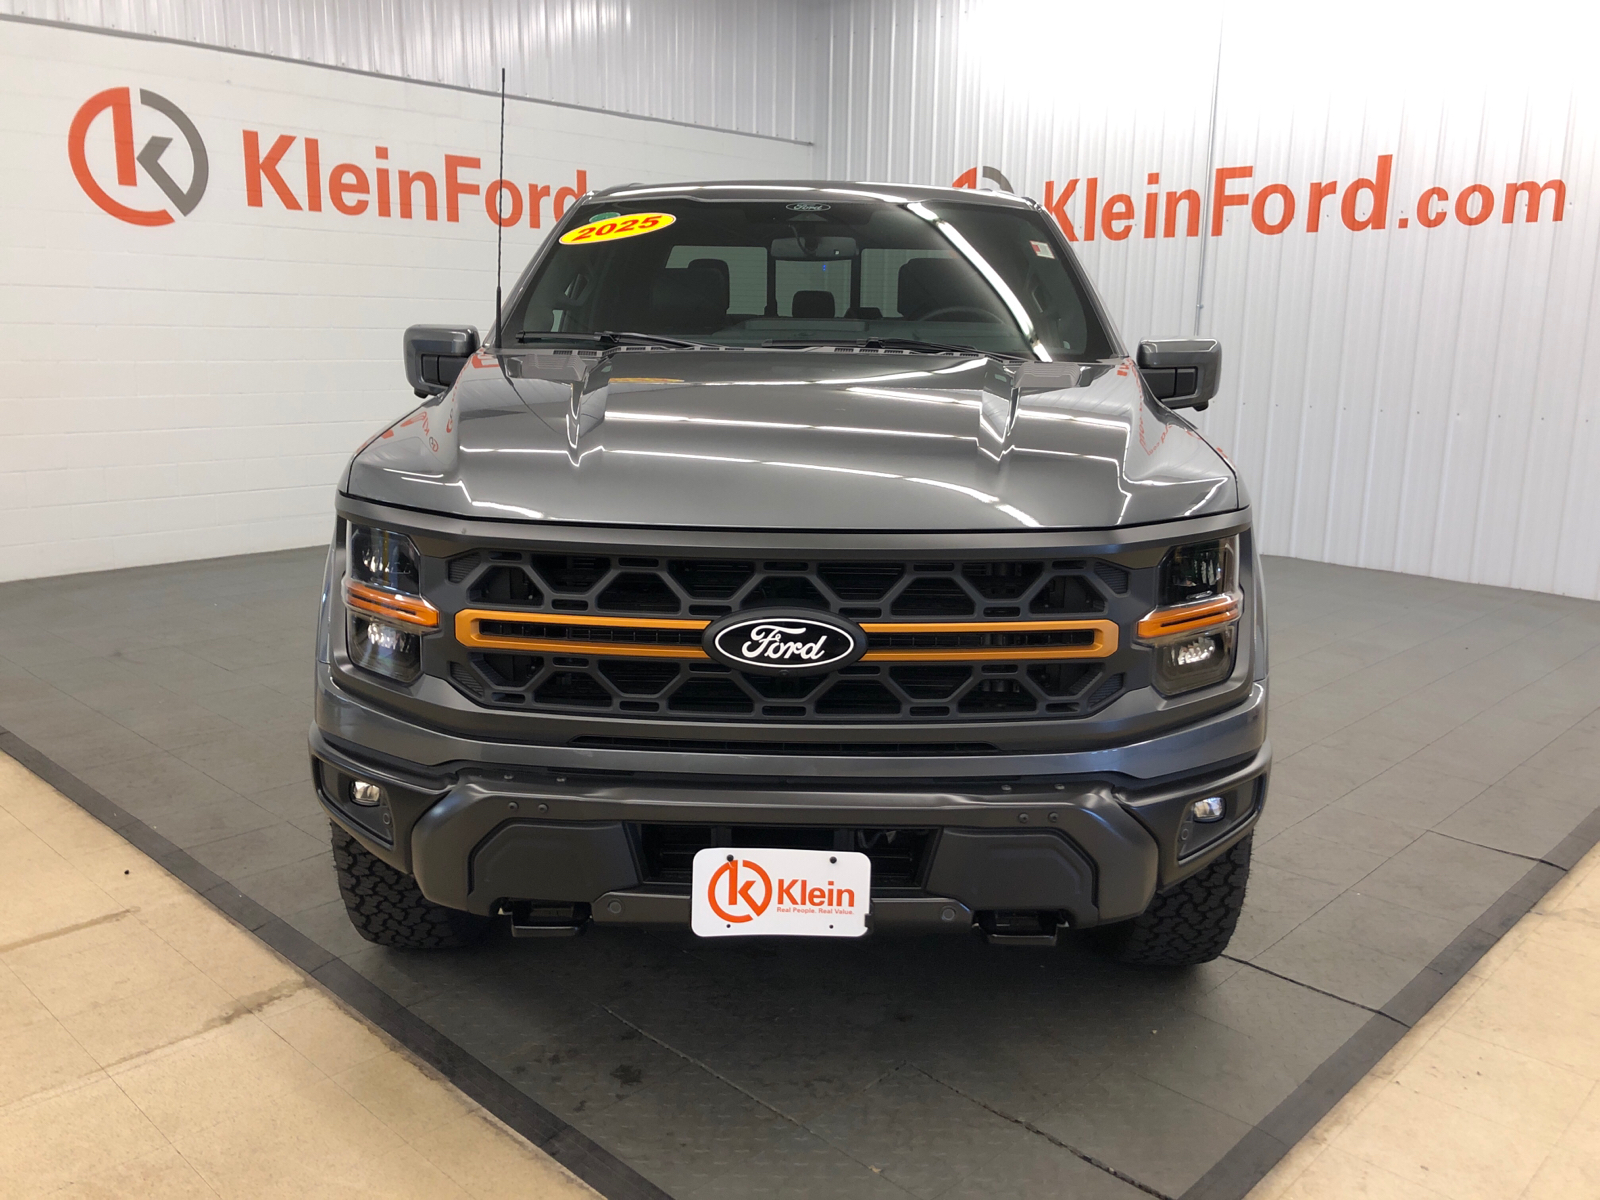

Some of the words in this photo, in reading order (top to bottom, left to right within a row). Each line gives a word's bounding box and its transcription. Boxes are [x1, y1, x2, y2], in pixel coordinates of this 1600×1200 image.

[1044, 154, 1566, 242] KleinFord.com
[571, 215, 663, 242] 2025
[741, 625, 828, 660] Ford
[777, 878, 855, 907] Klein
